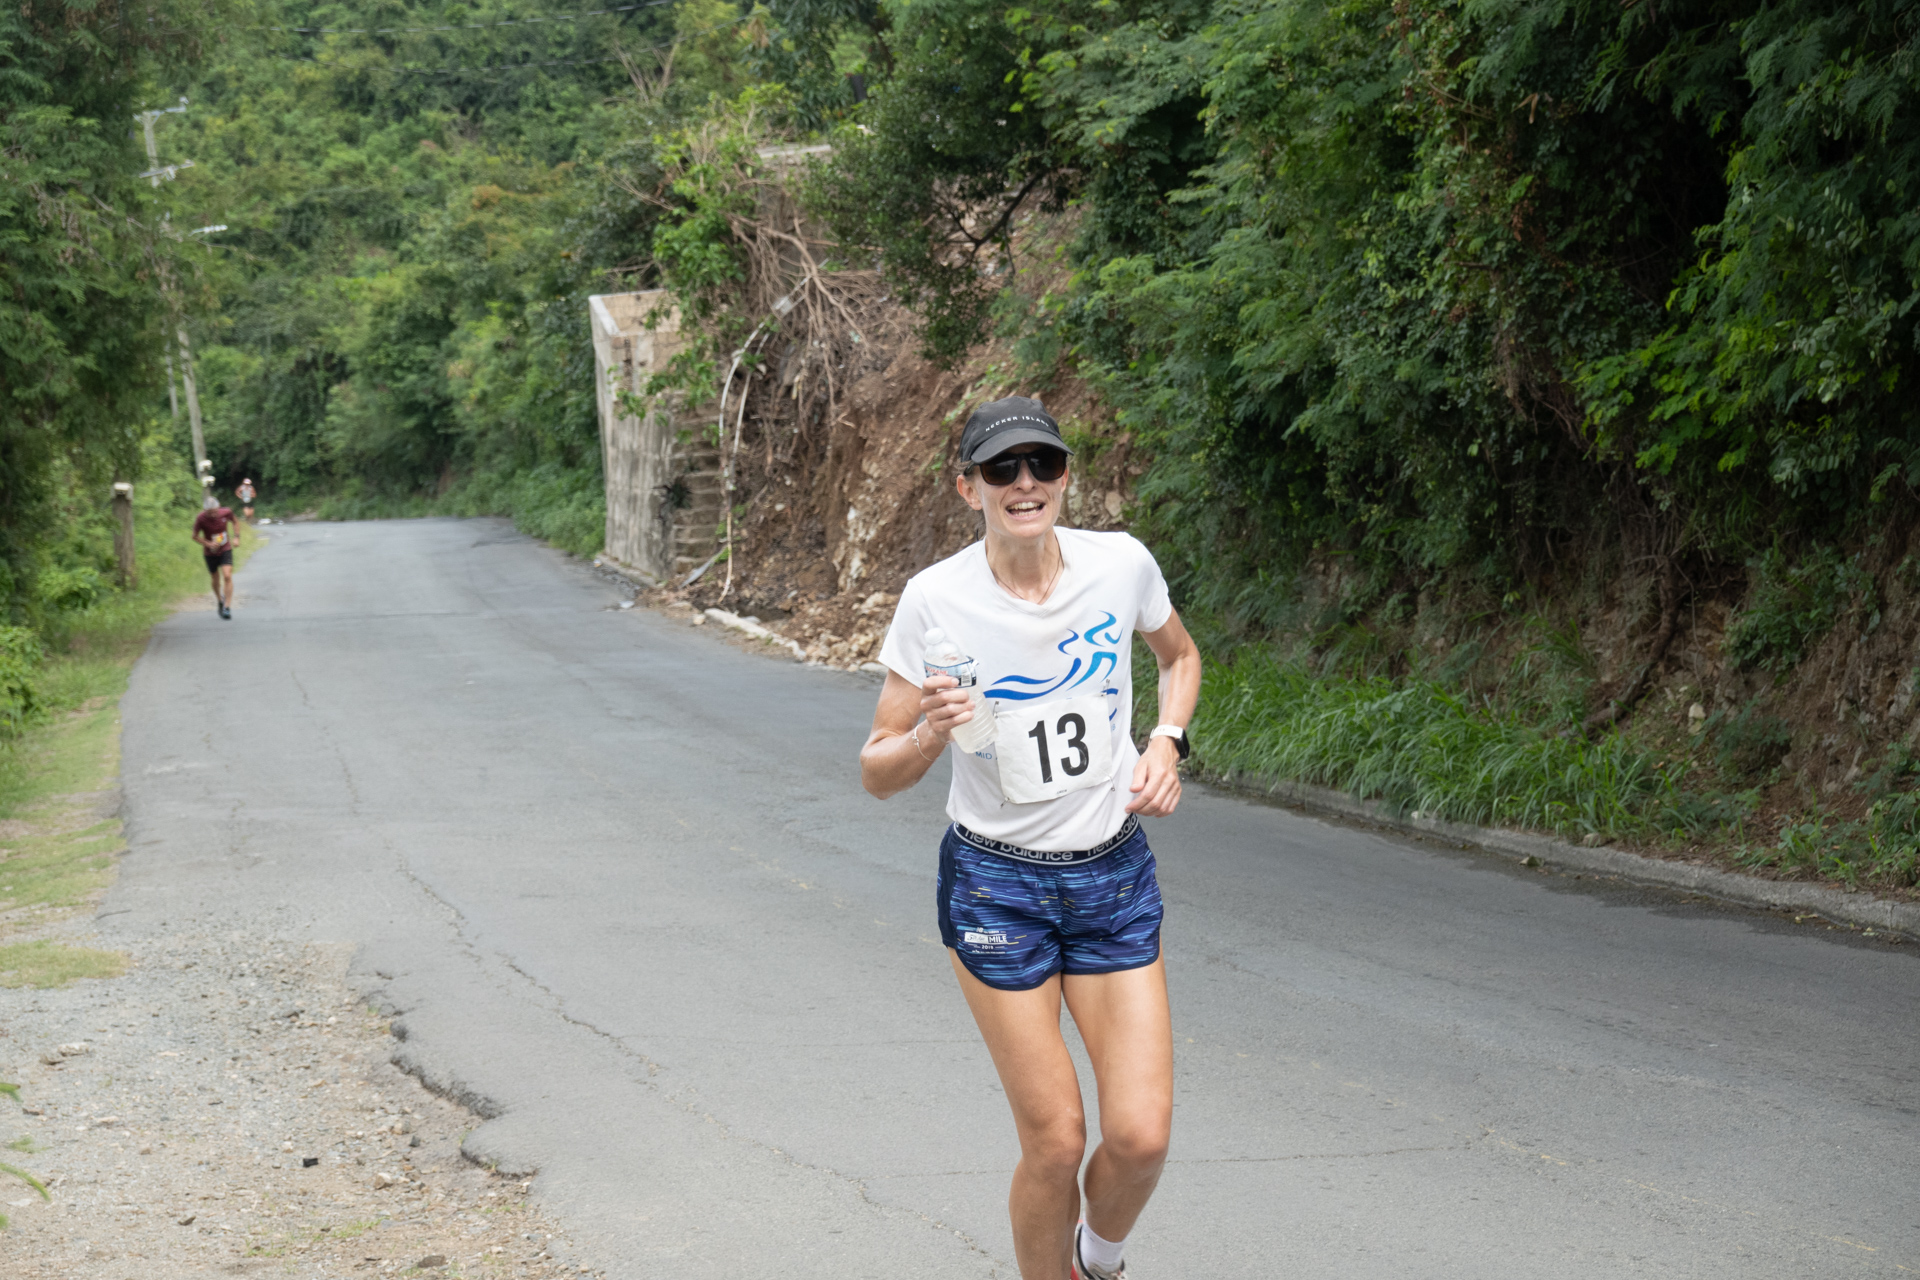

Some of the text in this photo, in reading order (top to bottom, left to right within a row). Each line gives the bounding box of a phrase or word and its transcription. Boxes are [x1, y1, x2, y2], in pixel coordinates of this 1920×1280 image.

[985, 416, 1018, 432] NECKER
[975, 751, 993, 760] MID
[1028, 712, 1090, 784] 13
[964, 828, 997, 848] new
[989, 935, 1007, 943] MILE
